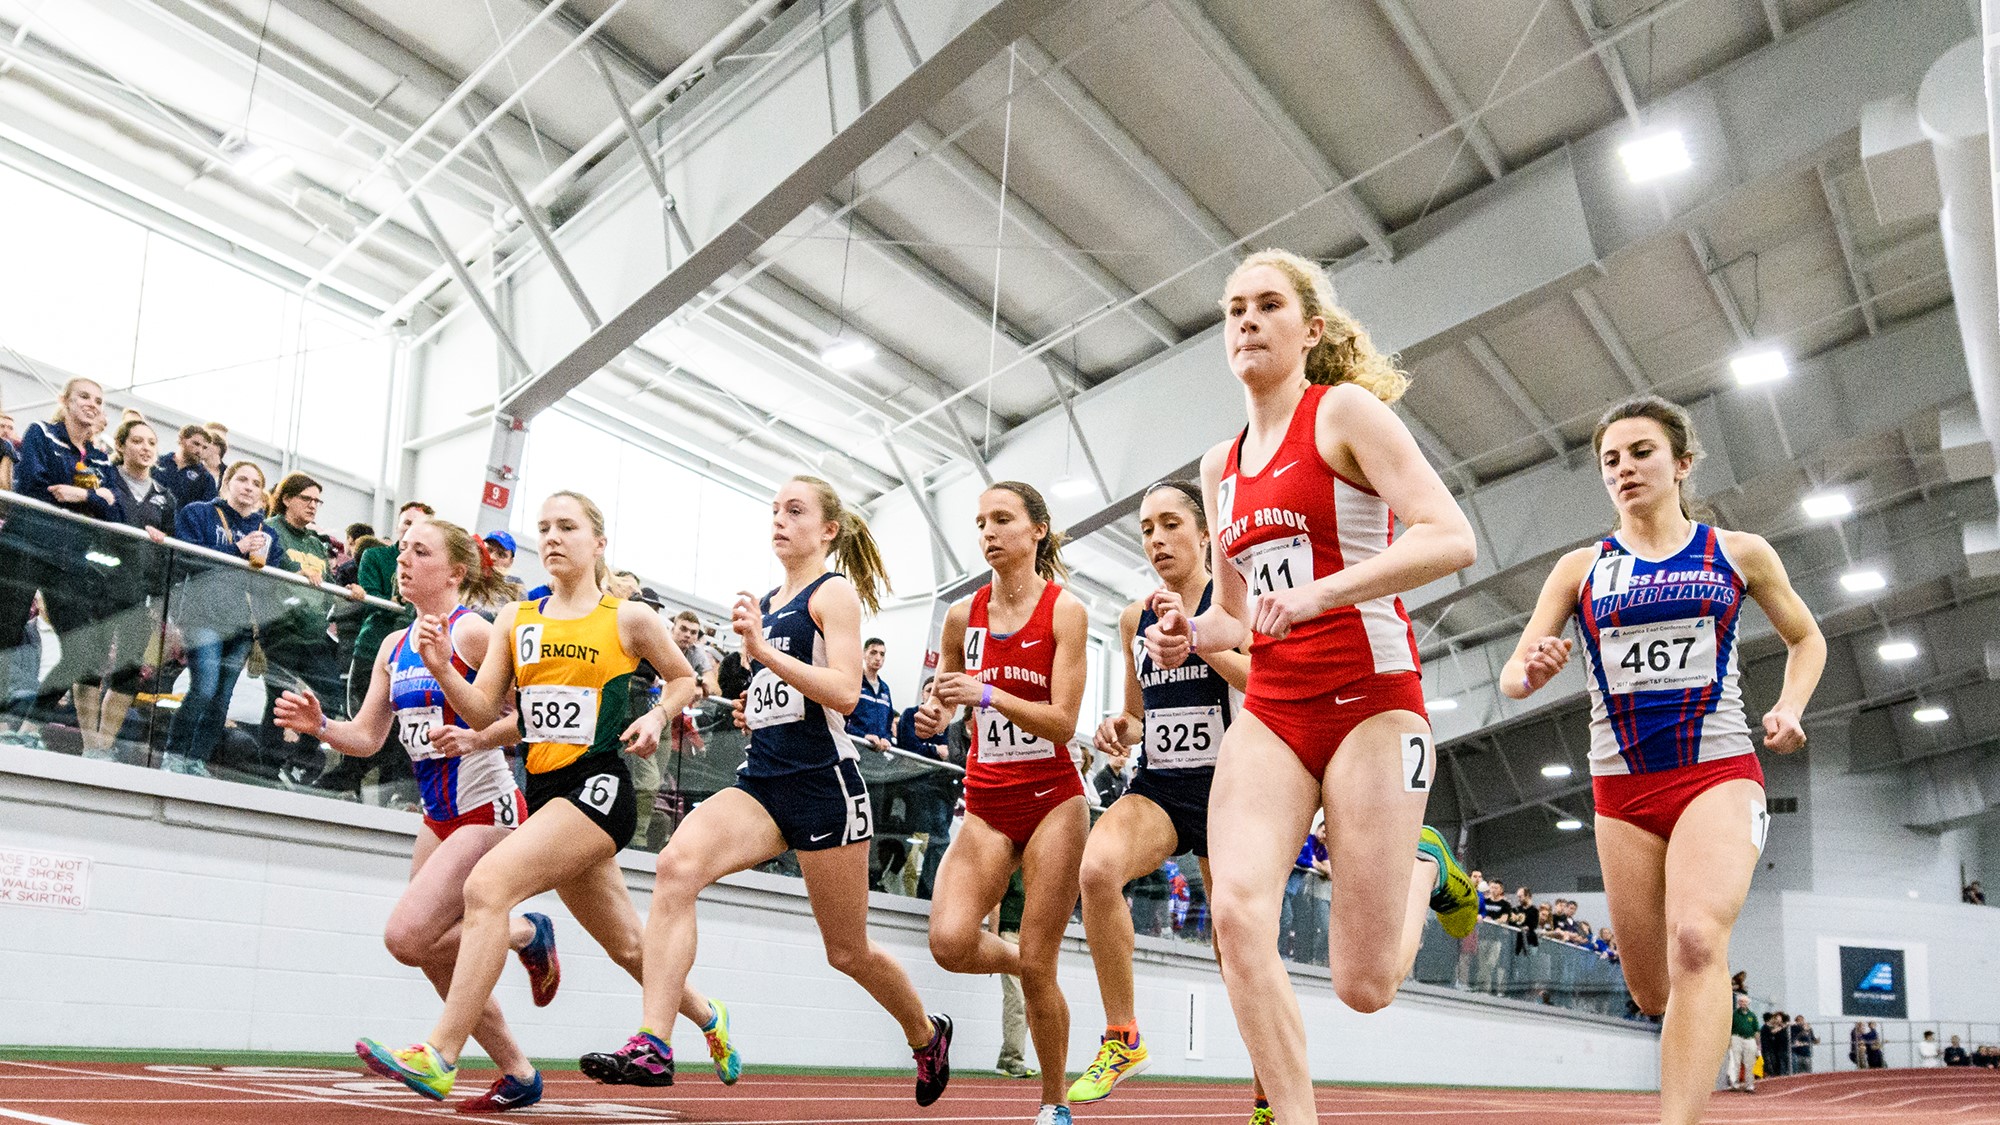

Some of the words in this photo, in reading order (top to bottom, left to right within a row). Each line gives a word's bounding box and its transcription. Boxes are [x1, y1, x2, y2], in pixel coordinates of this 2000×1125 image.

[492, 487, 500, 500] 9
[1220, 515, 1249, 555] TONY
[1254, 507, 1310, 533] BROOK
[1605, 557, 1623, 592] 1
[520, 626, 535, 662] 6
[541, 644, 599, 665] RMONT
[966, 630, 980, 667] 4
[1620, 637, 1696, 673] 467
[975, 667, 999, 683] ONY
[1004, 665, 1048, 688] BROOK
[753, 680, 790, 714] 346
[531, 701, 581, 729] 582
[1155, 722, 1211, 752] 325
[1409, 736, 1426, 789] 2
[589, 775, 610, 807] 6
[499, 793, 514, 826] 8
[854, 797, 868, 837] 5
[0, 865, 21, 876] CE
[28, 868, 74, 881] SHOES
[30, 856, 49, 868] DO
[55, 860, 82, 871] NOT
[2, 878, 47, 891] WALLS
[53, 882, 73, 893] OR
[17, 890, 81, 906] SKIRTING
